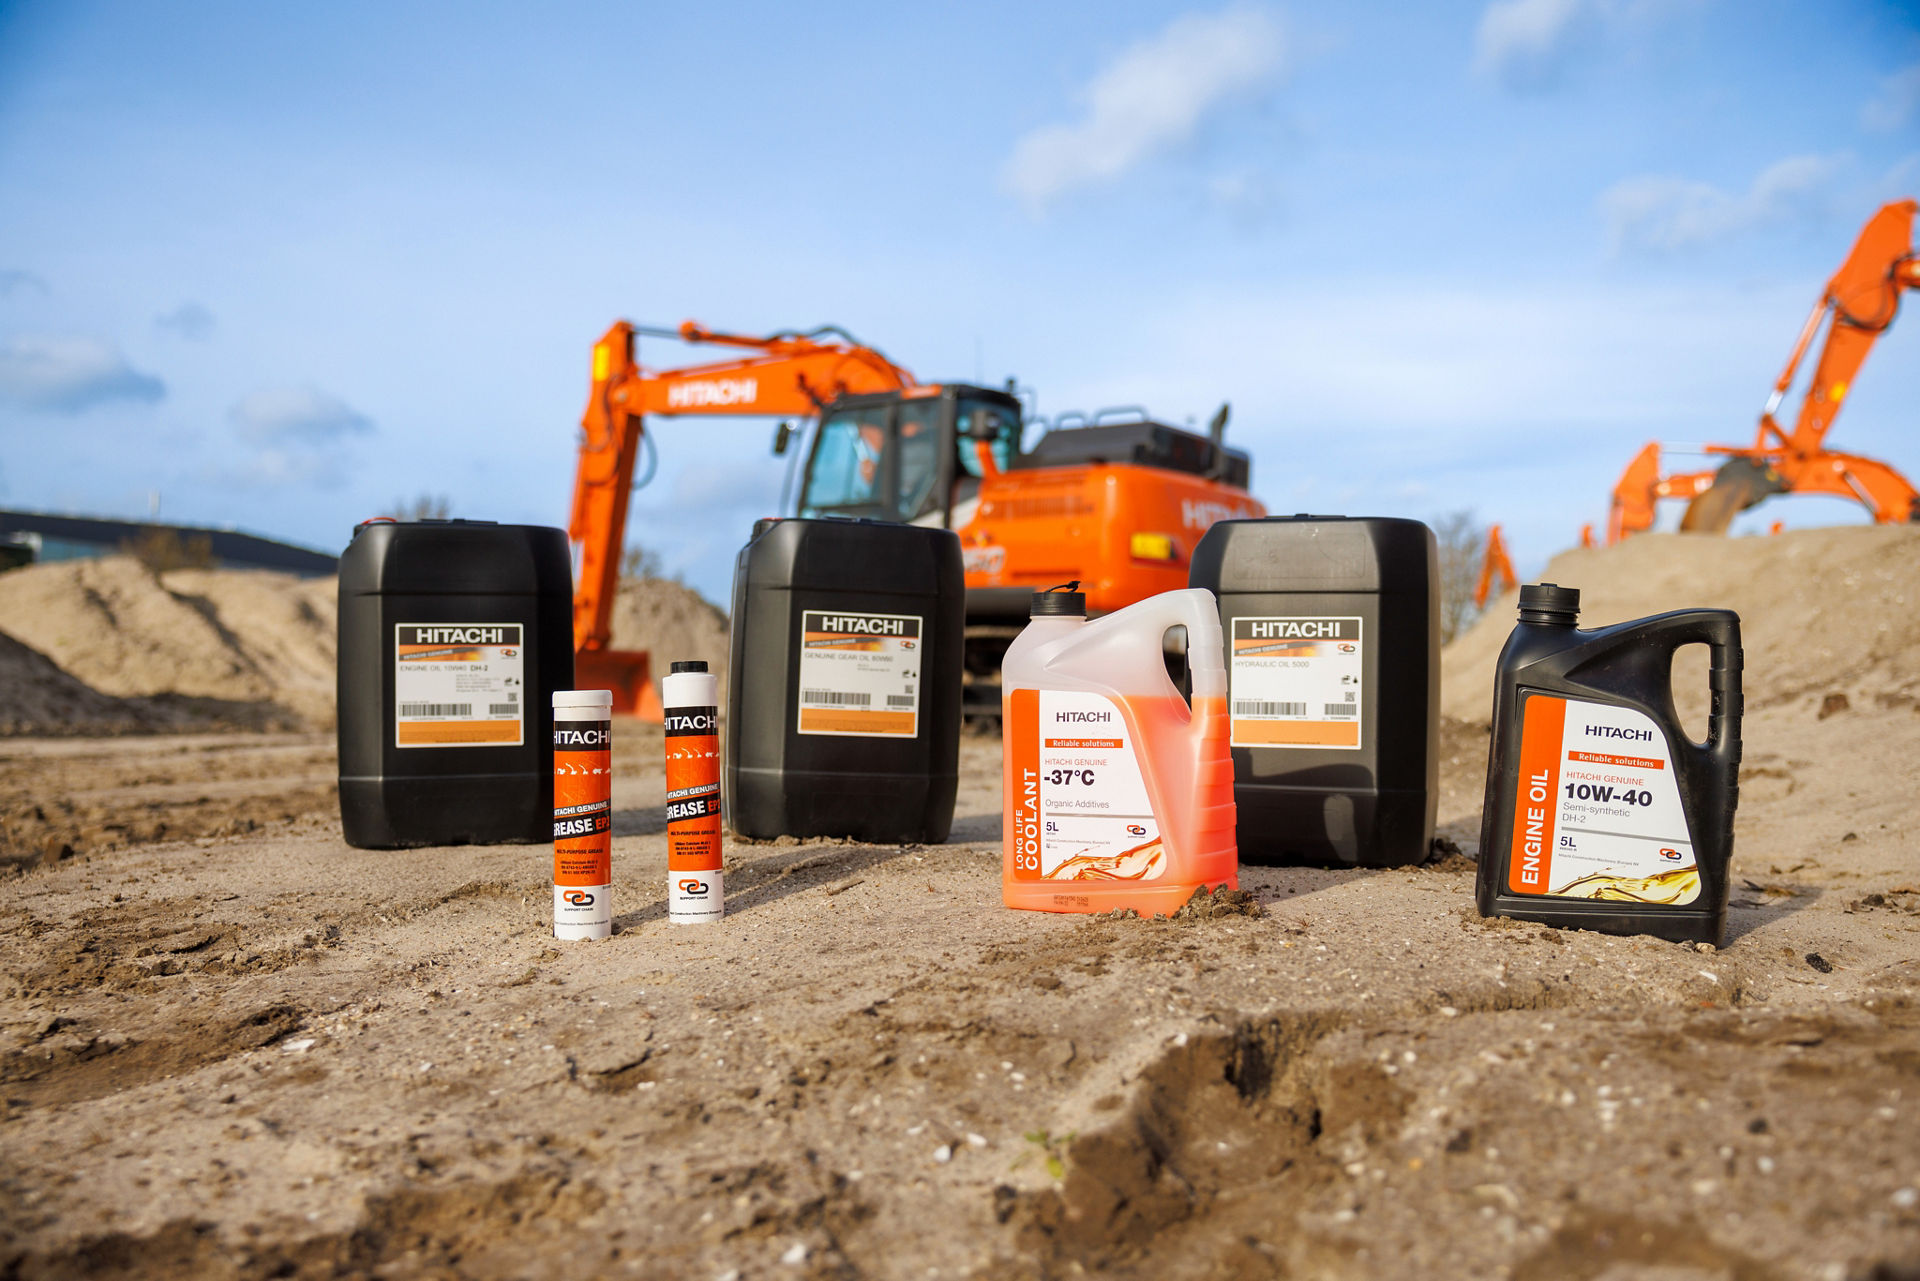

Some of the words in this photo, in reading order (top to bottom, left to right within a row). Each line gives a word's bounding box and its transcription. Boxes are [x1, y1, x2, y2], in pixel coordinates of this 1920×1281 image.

[668, 379, 757, 407] HITACHI
[822, 616, 904, 635] HITACHI
[1251, 622, 1341, 638] HITACHI
[416, 628, 503, 644] HITACHI
[805, 652, 836, 660] GENUINE
[1056, 712, 1111, 722] HITACHI
[1585, 725, 1652, 741] HITACHI
[1578, 753, 1612, 763] Reliable
[1615, 756, 1654, 768] solutions
[1044, 769, 1095, 786] -37°C
[1529, 769, 1549, 802] OIL
[1566, 771, 1601, 781] HITACHI
[1603, 774, 1644, 786] GENUINE
[1565, 783, 1653, 807] 10W-40
[1045, 799, 1073, 809] Organic
[1075, 800, 1110, 809] Additives
[1563, 801, 1630, 817] Semi-synthetic
[1024, 768, 1038, 870] COOLANT
[1562, 813, 1586, 823] DH-2
[1046, 822, 1059, 832] 5L
[1521, 807, 1545, 884] ENGINE
[1560, 836, 1576, 847] 5L
[1016, 838, 1024, 870] LONG
